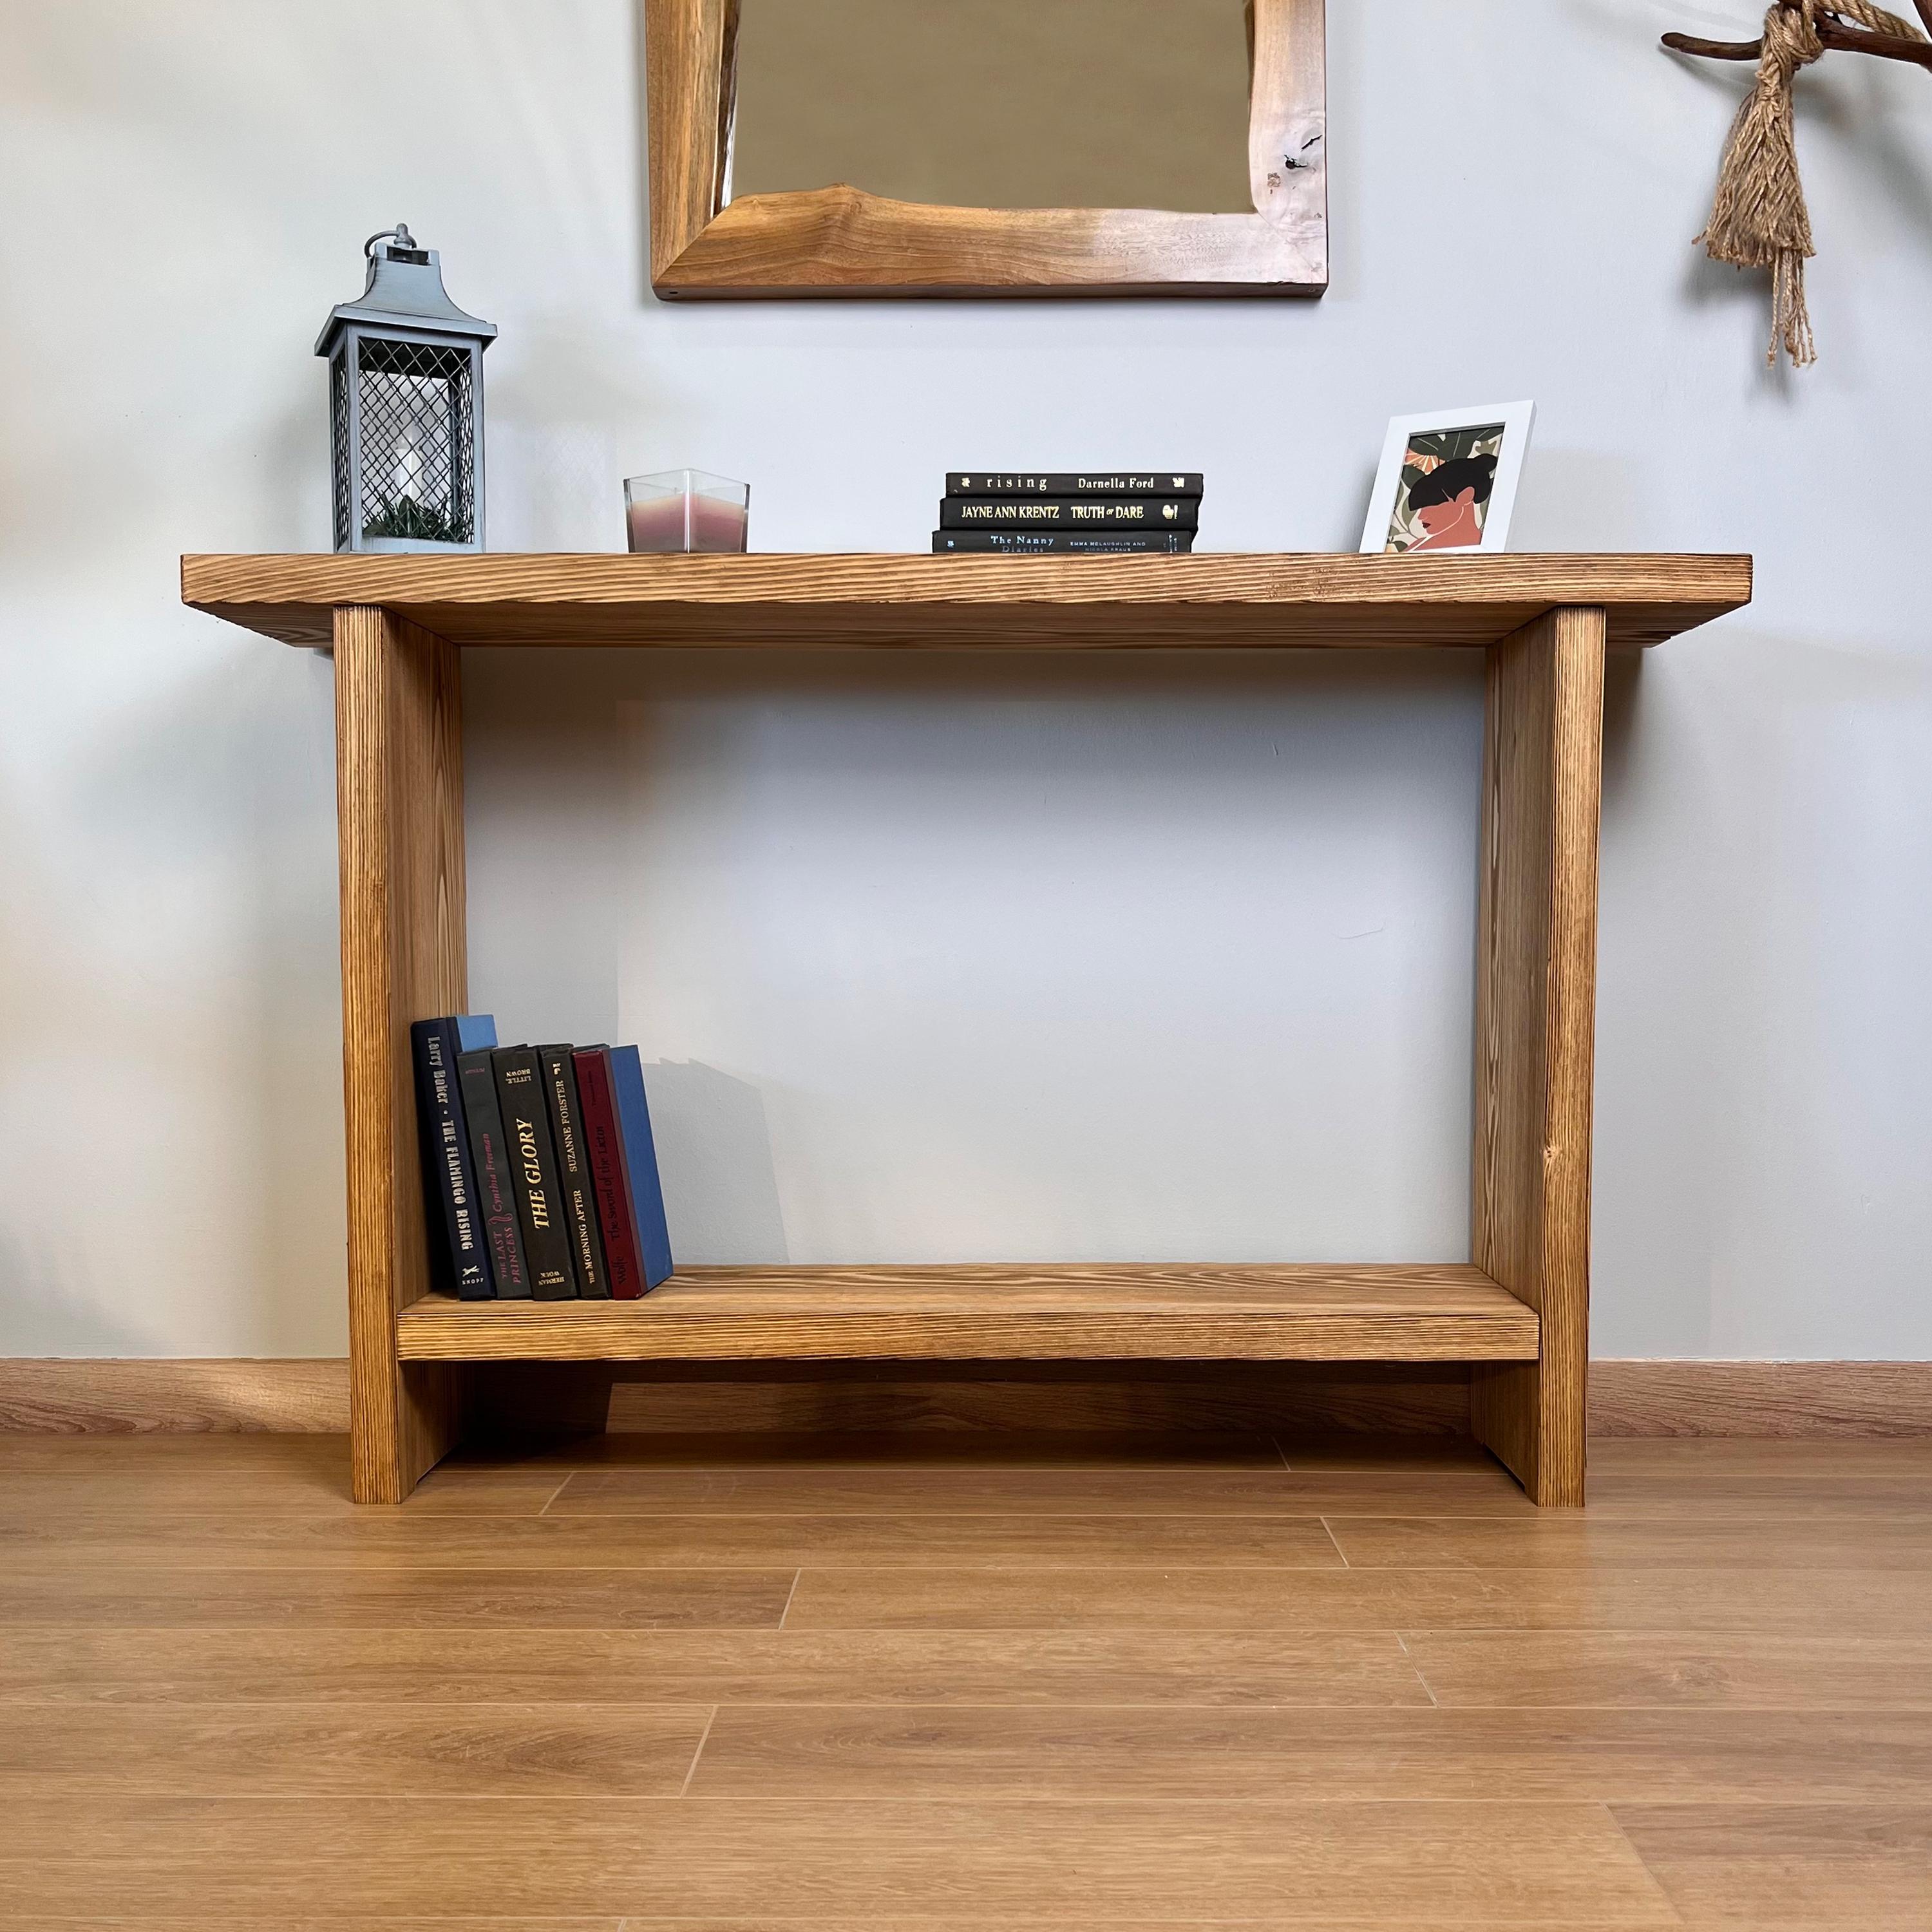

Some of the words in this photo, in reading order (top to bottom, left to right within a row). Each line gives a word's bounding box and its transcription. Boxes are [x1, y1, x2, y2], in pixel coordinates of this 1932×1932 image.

[987, 475, 1047, 491] rising
[1078, 477, 1124, 489] Darnella
[1130, 477, 1154, 489] Ford
[961, 506, 993, 518] JAYNE
[994, 506, 1017, 518] ANN
[1019, 506, 1060, 519] KRENTZ
[1070, 506, 1105, 519] TRUTH
[1115, 506, 1144, 519] DARE
[990, 535, 1012, 545] The
[1016, 535, 1054, 547] Nanny
[427, 1036, 442, 1066] Larry
[433, 1070, 449, 1104] Baker
[506, 1068, 531, 1077] BROWN
[555, 1080, 570, 1124] FORSTER
[442, 1119, 457, 1142] THE
[482, 1133, 495, 1171] Freeman
[516, 1118, 542, 1185] GLORY
[563, 1126, 578, 1173] SUZANNE
[445, 1146, 466, 1204] FLAMINGO
[597, 1175, 614, 1186] of
[489, 1174, 503, 1212] Cynthia
[528, 1189, 550, 1229] THE
[573, 1189, 586, 1222] AFTER
[455, 1209, 474, 1250] RISING
[493, 1231, 506, 1260] LAST
[504, 1227, 521, 1283] PRINCESS
[578, 1223, 593, 1270] MORNING
[587, 1270, 595, 1285] THE
